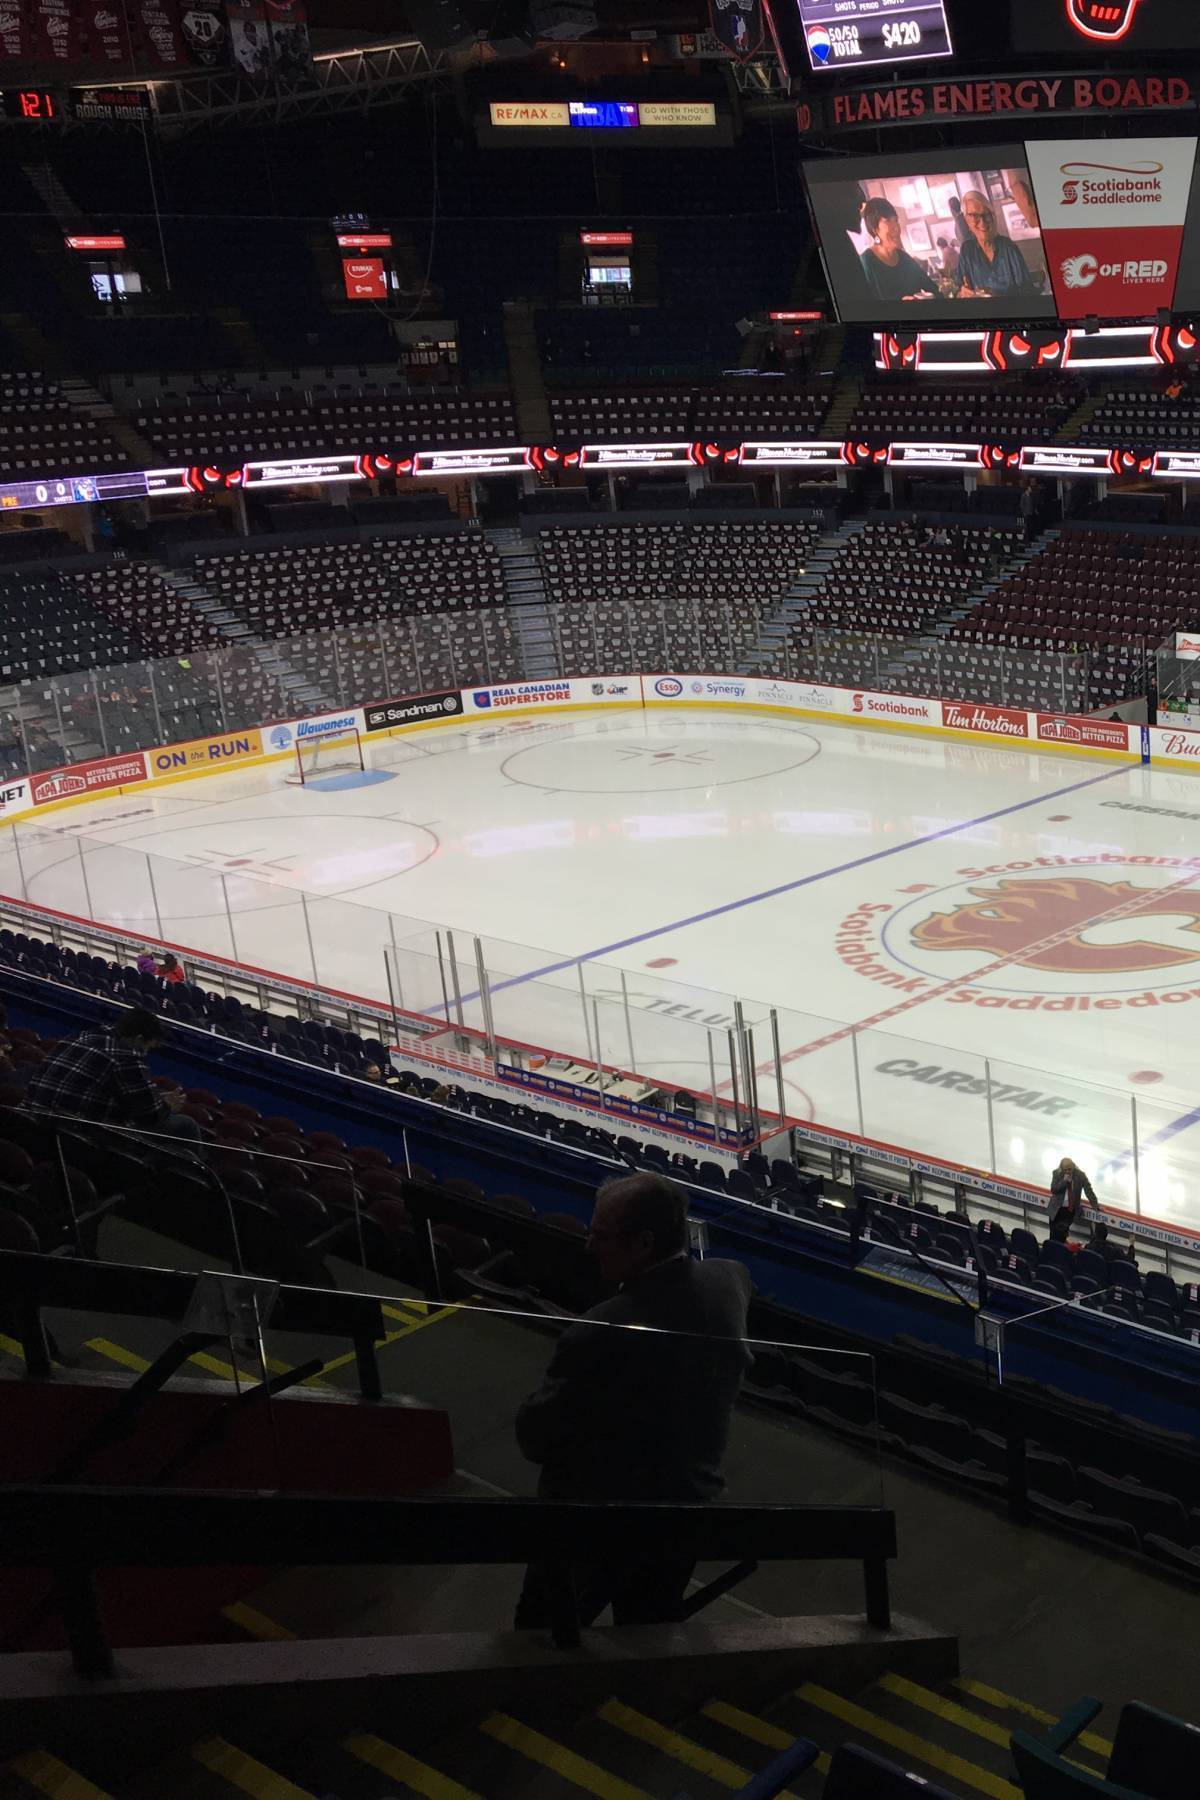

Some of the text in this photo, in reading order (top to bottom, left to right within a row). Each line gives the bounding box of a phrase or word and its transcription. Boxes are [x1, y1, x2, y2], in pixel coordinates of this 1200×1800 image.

[835, 2, 857, 12] SHOTS
[859, 1, 879, 11] PERIOD
[828, 25, 860, 41] 50/50
[881, 20, 921, 49] $420
[832, 40, 863, 57] TOTAL
[833, 88, 926, 124] FLAMES
[934, 79, 1062, 116] ENERGY
[1074, 77, 1192, 109] BOARD
[76, 103, 150, 120] ROUGH HOUSE
[1082, 177, 1163, 192] Scotiabank
[1082, 192, 1163, 205] Saddledome
[1099, 259, 1168, 278] OF RED
[36, 485, 48, 503] 0
[56, 482, 66, 495] 0
[492, 683, 570, 698] REAL CANADIAN
[659, 682, 679, 691] Esso
[706, 683, 746, 697] Synergy
[493, 691, 571, 707] SUPERSTORE
[387, 702, 442, 721] Sandman
[867, 699, 929, 718] Scotiabank
[297, 715, 356, 737] Wawanesa
[944, 706, 1025, 737] Tim Hortons
[1041, 725, 1058, 737] PAPA
[1082, 732, 1105, 742] BETTER
[156, 738, 251, 770] ON the RUN
[87, 772, 118, 785] BETTER
[834, 902, 935, 994] Scotiabank
